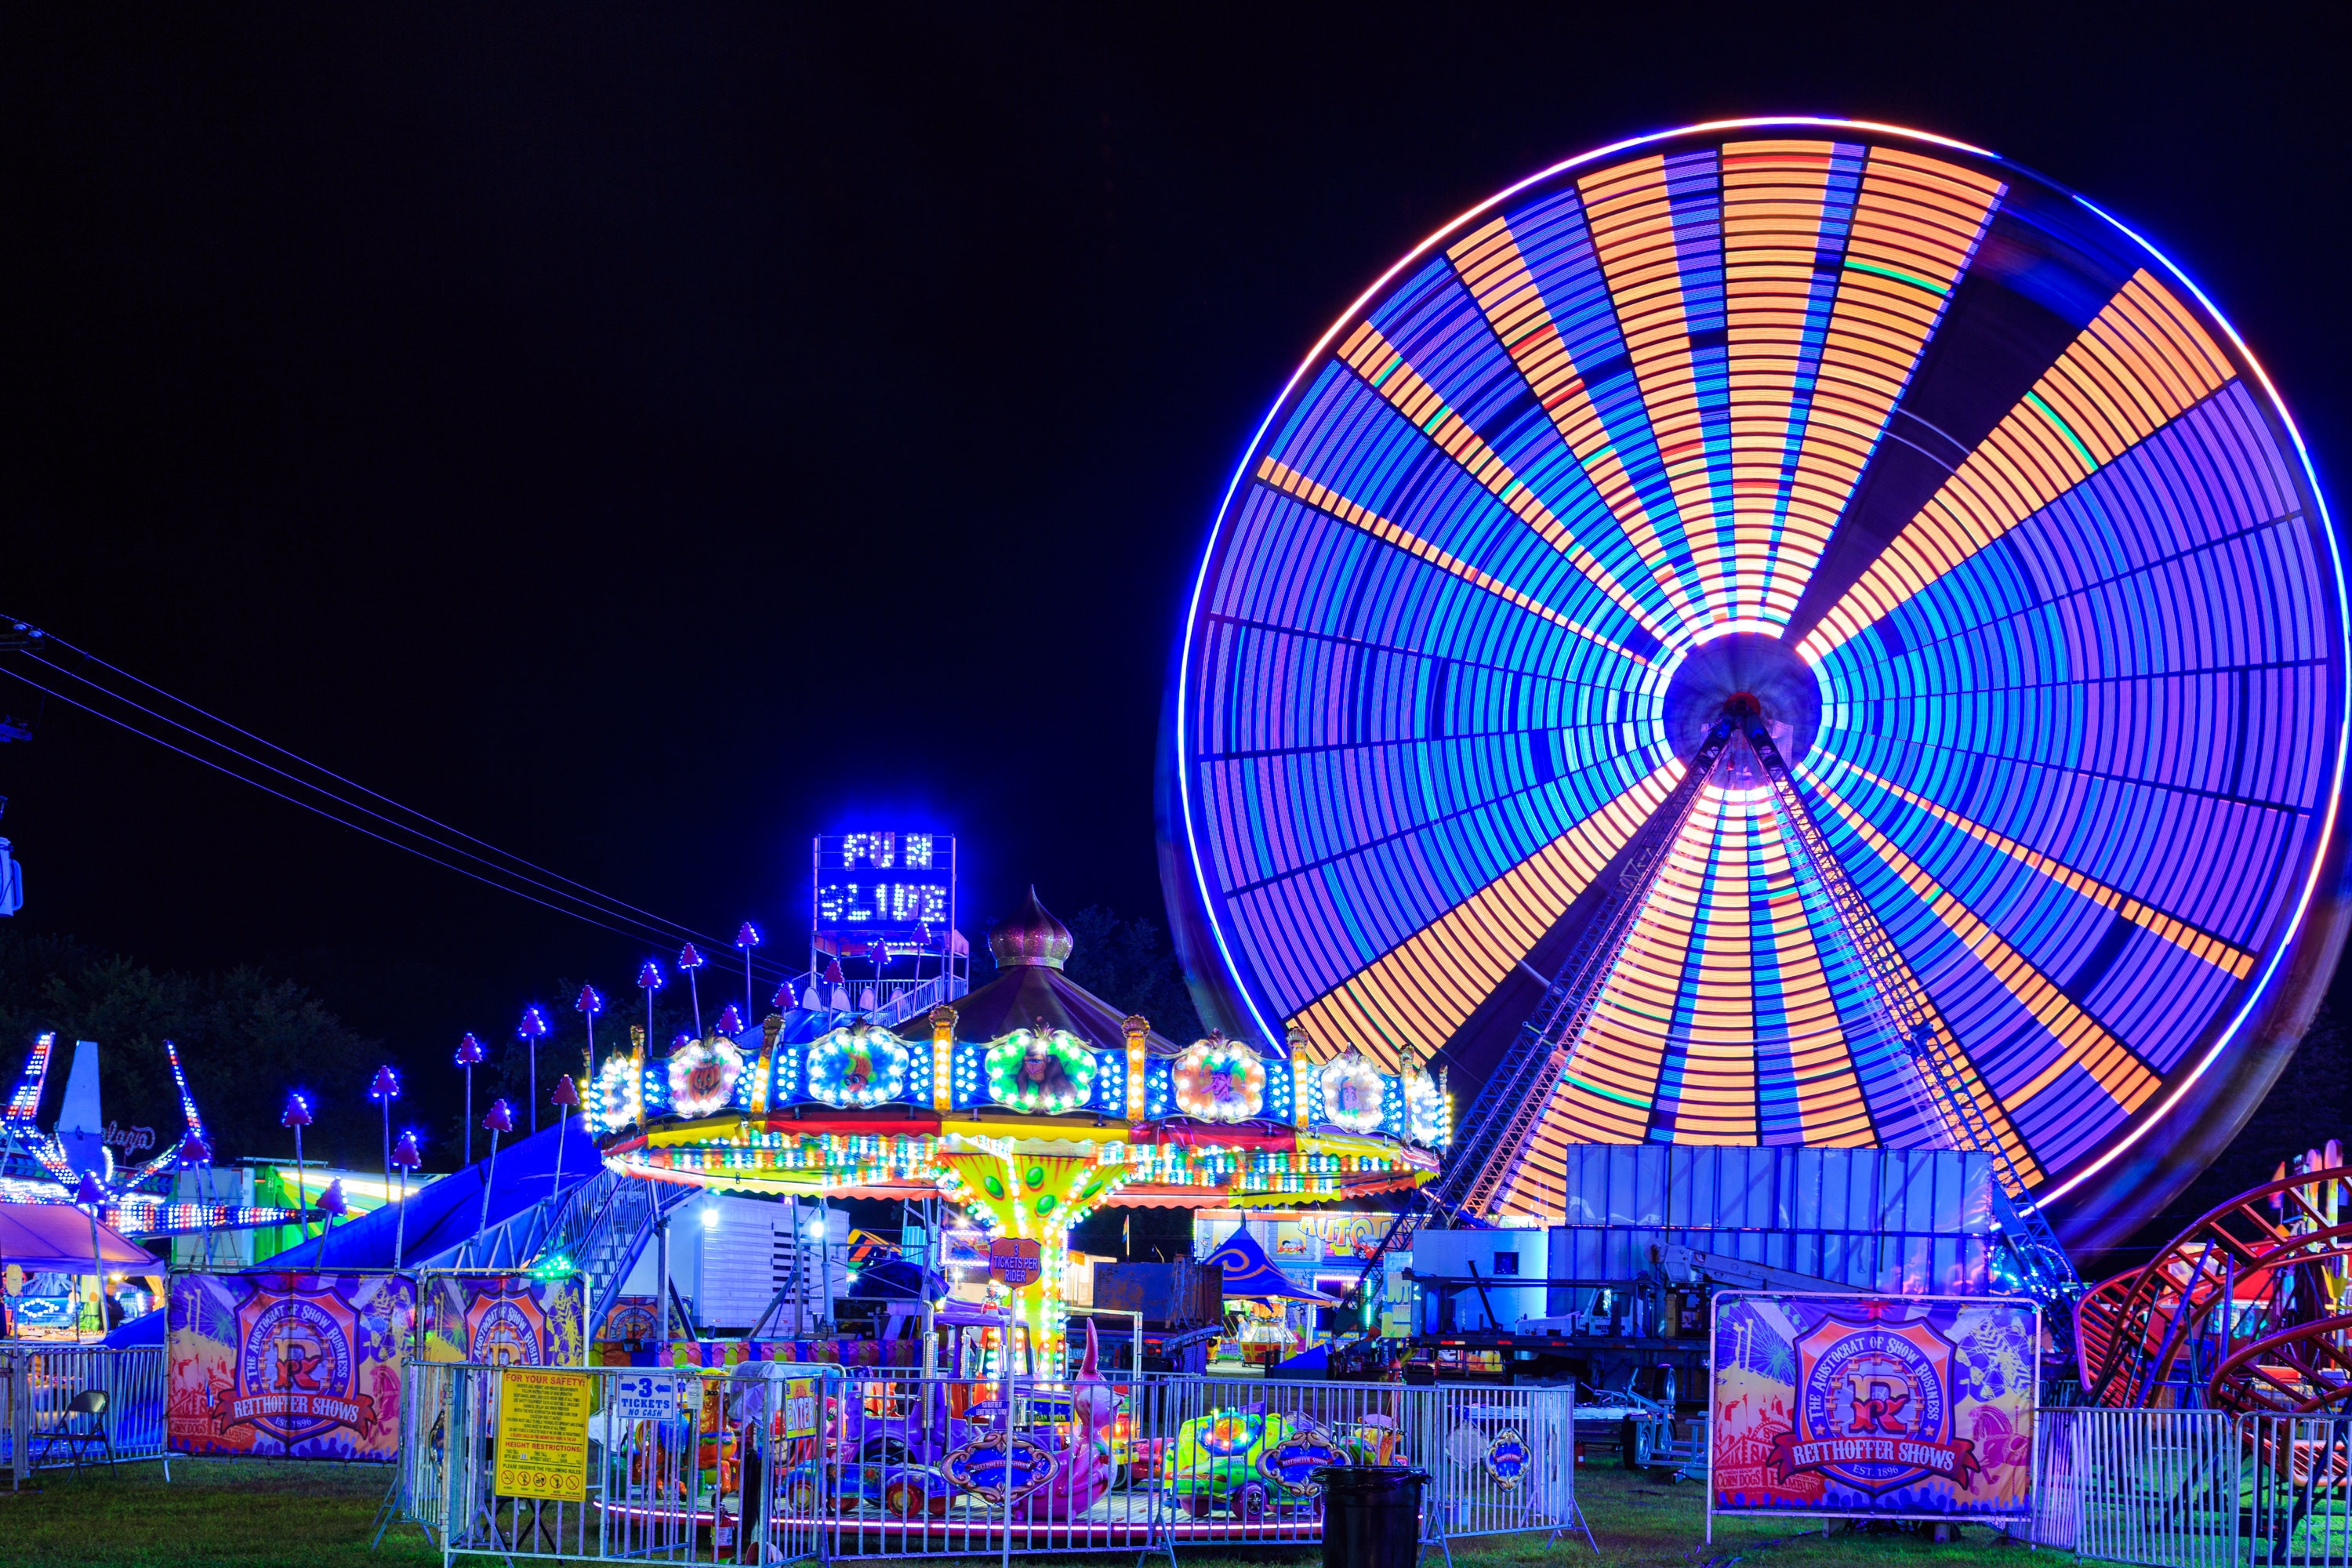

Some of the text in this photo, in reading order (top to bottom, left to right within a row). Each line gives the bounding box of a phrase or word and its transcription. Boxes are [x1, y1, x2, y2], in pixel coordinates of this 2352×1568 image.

[844, 831, 933, 871] FUN
[819, 883, 947, 923] SLIDE
[1298, 1215, 1374, 1249] AUTO
[1014, 1243, 1019, 1256] 3
[993, 1255, 1038, 1270] TICKETS PER
[1004, 1269, 1026, 1283] RIDER
[246, 1304, 348, 1381] THE ARISTOCRAT OF SHOW BUSINESS
[474, 1308, 498, 1359] ARISTOCRAT
[507, 1307, 527, 1331] SHOW
[524, 1330, 539, 1366] BUSIN
[506, 1374, 586, 1387] FOR YOUR SAFETY:
[638, 1377, 652, 1398] 3
[1809, 1337, 1940, 1422] THE ARISTOCRAT OF SHOW BUSINESS
[233, 1395, 360, 1423] REITHOFFER SHOWS
[622, 1399, 670, 1409] TICKETS
[787, 1396, 815, 1432] ENTER
[532, 1443, 583, 1453] RESTRICTIONS:
[1792, 1439, 1955, 1471] REITHOFFER SHOWS
[1718, 1470, 1762, 1488] CORN DOGS
[1853, 1465, 1899, 1477] EST. 1896
